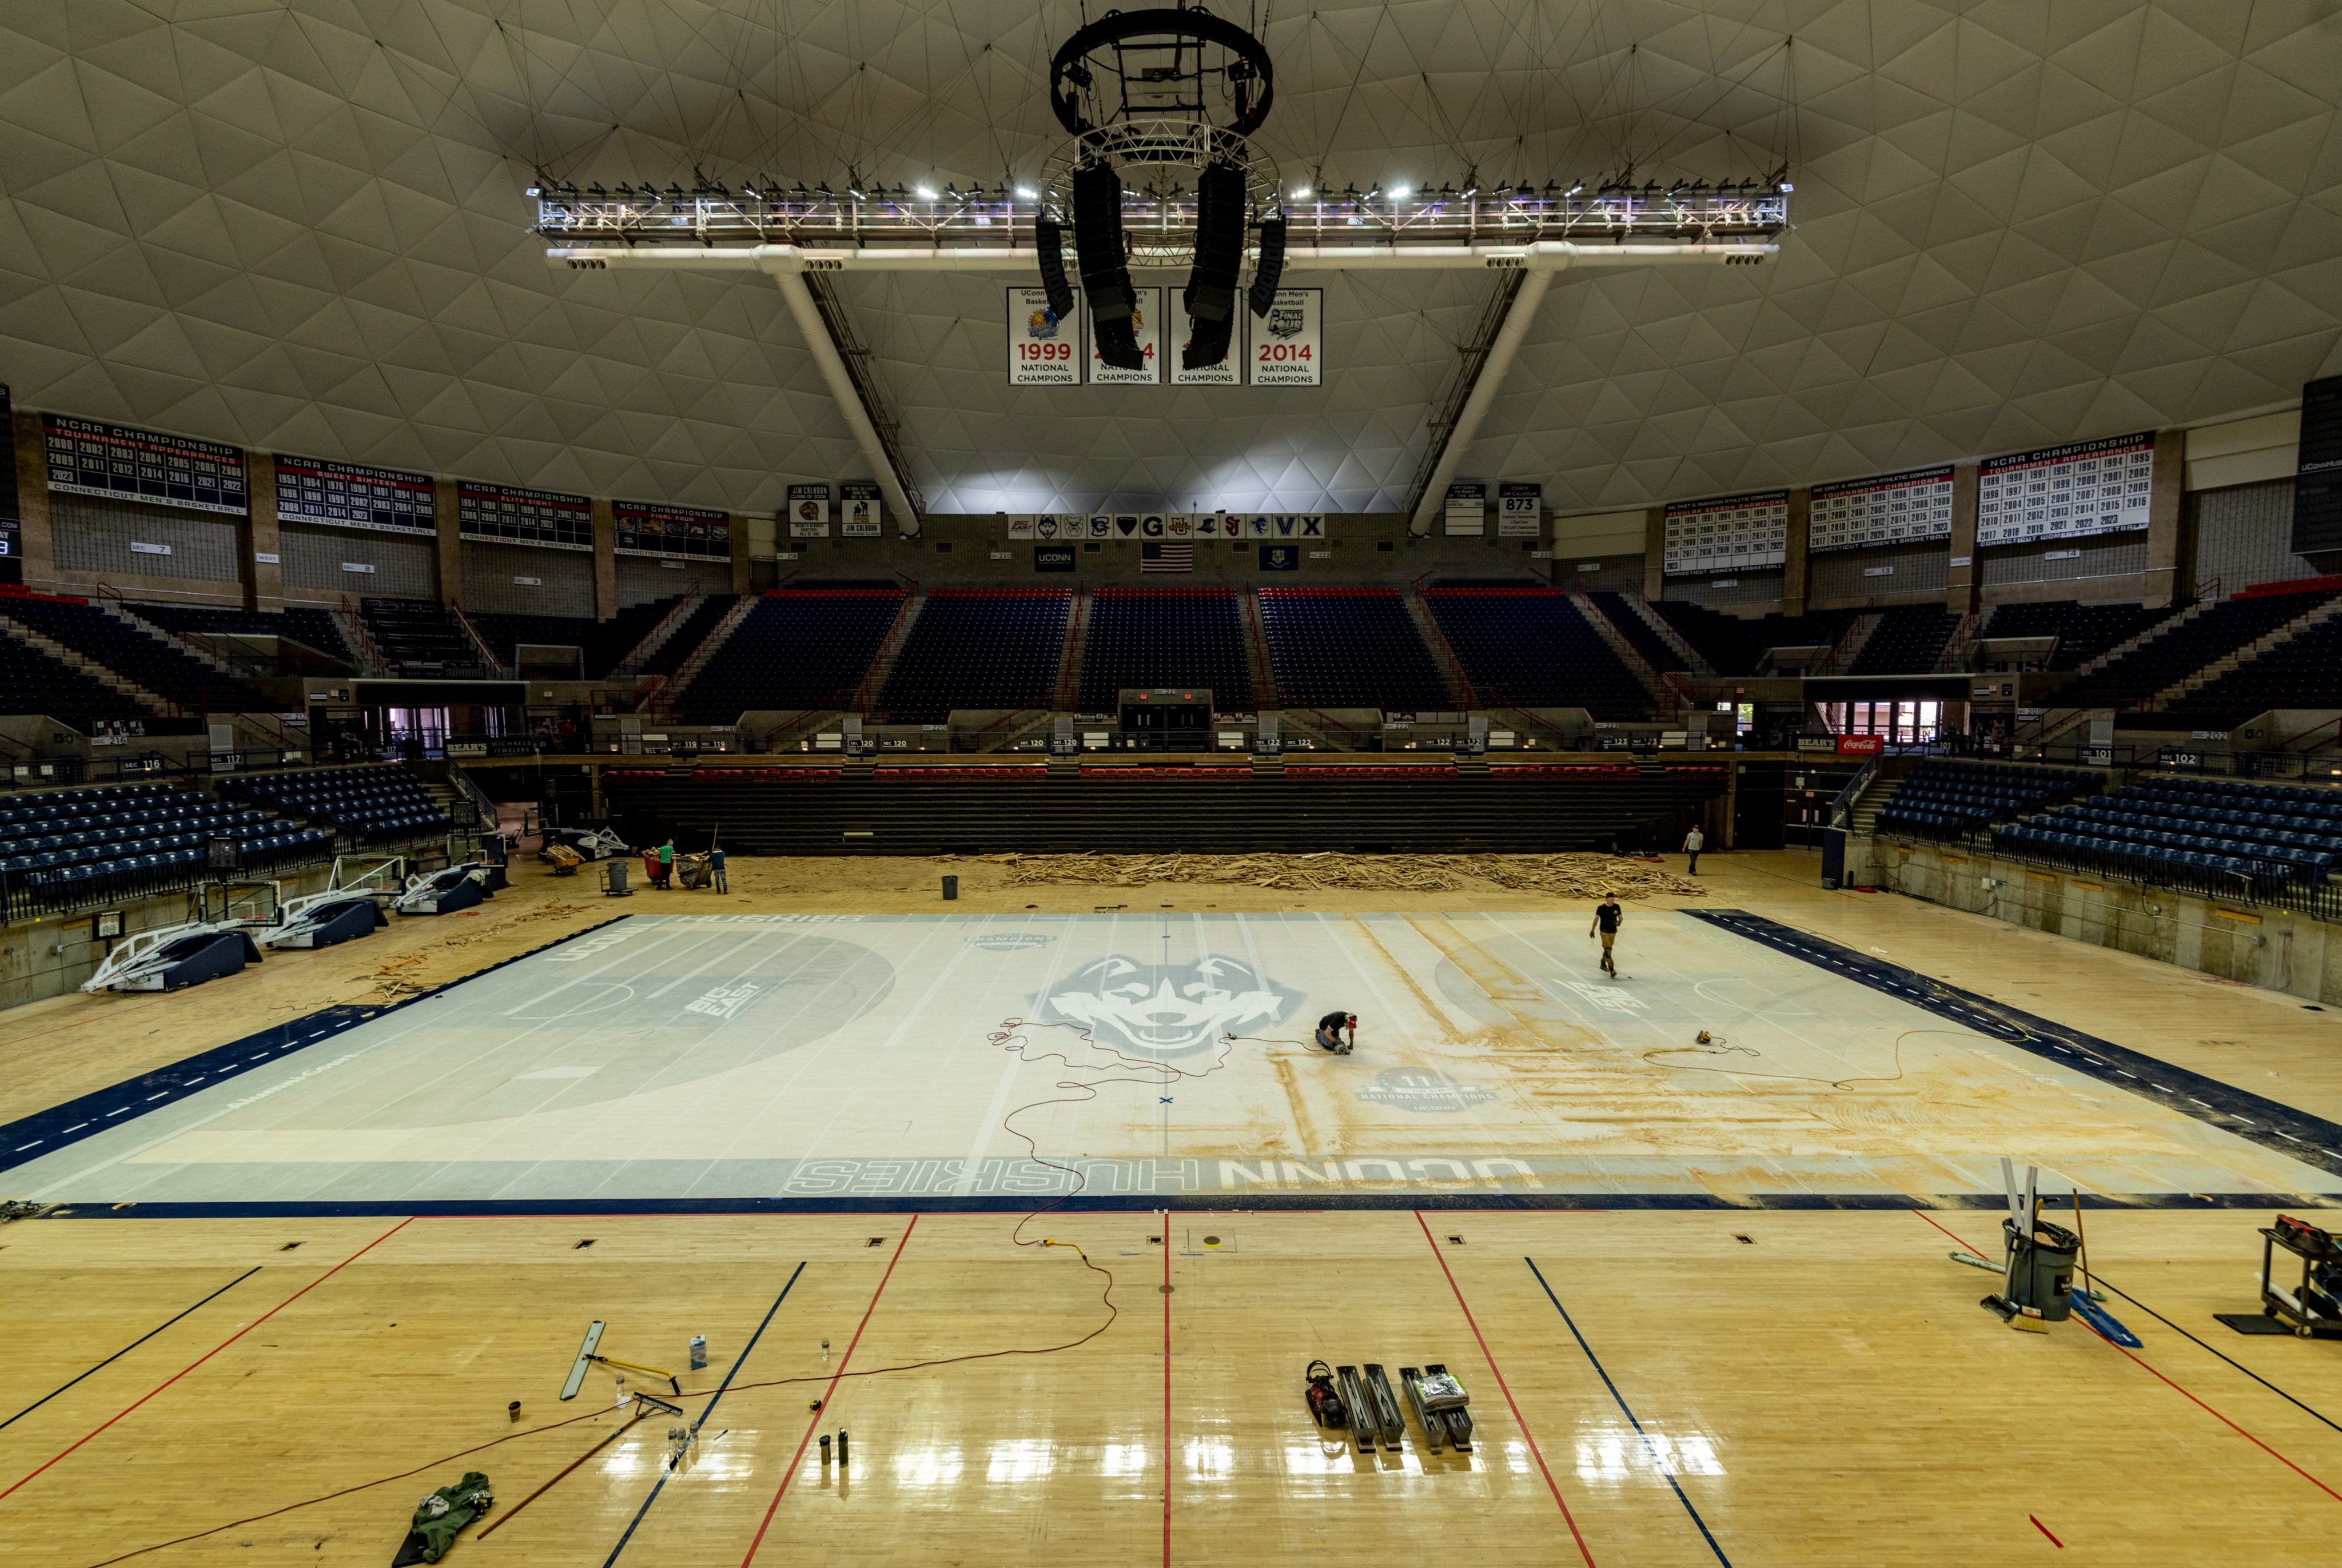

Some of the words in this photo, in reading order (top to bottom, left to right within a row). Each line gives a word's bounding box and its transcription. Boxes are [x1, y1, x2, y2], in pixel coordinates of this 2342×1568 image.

[1279, 310, 1303, 320] FINAL
[1018, 344, 1070, 360] 1999
[1259, 344, 1312, 361] 2014
[55, 428, 144, 449] TOURNAMENT
[150, 445, 236, 464] APPEARANCES
[56, 418, 103, 433] NCAA
[113, 429, 233, 455] CHAMPIONSHIP
[48, 436, 73, 450] 2000
[80, 442, 103, 455] 2002
[111, 447, 133, 460] 2003
[140, 452, 162, 464] 2004
[168, 456, 189, 469] 2005
[195, 461, 216, 473] 2006
[222, 465, 241, 477] 2008
[1989, 458, 2058, 474] TOURNAMENT
[2063, 444, 2145, 462] APPEARANCES
[1990, 455, 2026, 467] NCAA
[2033, 435, 2144, 461] CHAMPIONSHIP
[284, 457, 321, 469] NCAA
[328, 464, 424, 484] CHAMPIONSHIP
[317, 471, 352, 480] SWEET
[356, 476, 397, 486] SIXTEEN
[1847, 480, 1878, 489] AMERICAN
[1879, 475, 1908, 484] ATHLETIC
[1910, 468, 1950, 479] CONFERENCE
[1983, 477, 1999, 486] 1989
[2007, 473, 2022, 483] 1990
[2030, 469, 2046, 479] 1991
[2054, 465, 2070, 475] 1992
[2079, 461, 2096, 471] 1993
[2104, 457, 2122, 468] 1994
[2131, 452, 2150, 464] 1995
[1823, 486, 1881, 499] TOURNAMENT
[1885, 477, 1939, 490] CHAMPIONS
[1983, 490, 1998, 500] 1996
[2006, 486, 2021, 496] 1997
[2029, 482, 2045, 492] 1998
[2053, 479, 2070, 488] 1999
[2077, 475, 2096, 485] 2000
[2103, 471, 2122, 481] 2001
[2129, 467, 2149, 478] 2002
[54, 484, 134, 500] CONNECTICUT
[140, 495, 172, 505] MEN'S
[178, 501, 242, 514] BASKETBALL
[465, 484, 497, 493] NCAA
[502, 488, 584, 504] CHAMPIONSHIP
[1751, 492, 1785, 500] CONFERENCE
[620, 503, 646, 511] NCAA
[651, 506, 722, 518] CHAMPIONSHIP
[1507, 498, 1533, 510] 873
[1739, 500, 1786, 508] CHAMPIONS
[1981, 516, 1998, 526] 2010
[2004, 513, 2021, 523] 2011
[2027, 510, 2044, 520] 2012
[2052, 507, 2069, 517] 2013
[2075, 504, 2094, 514] 2014
[2101, 500, 2120, 511] 2015
[2128, 496, 2146, 507] 2016
[282, 514, 348, 525] CONNECTICUT
[380, 525, 432, 534] BASKETBALL
[1143, 517, 1163, 536] G
[1275, 517, 1296, 536] V
[1303, 517, 1321, 535] X
[464, 533, 516, 544] CONNECTICUT
[545, 542, 589, 550] BASKETBALL
[1810, 544, 1859, 553] CONNECTICUT
[1862, 538, 1897, 548] WOMEN'S
[1899, 534, 1950, 544] BASKETBALL
[1980, 536, 2036, 547] CONNECTICUT
[2041, 530, 2080, 540] WOMEN'S
[2084, 523, 2144, 535] BASKETBALL
[1843, 740, 1877, 749] Coca-Cola
[2206, 731, 2226, 740] 202
[226, 755, 241, 763] 117
[2096, 749, 2112, 758] 101
[2175, 754, 2196, 763] 102
[143, 760, 161, 769] 116
[674, 915, 867, 923] HUSKIES
[545, 921, 660, 962] UCONN
[684, 986, 736, 1015] BIG
[703, 981, 762, 1019] EAST
[226, 1076, 306, 1109] Alumni
[301, 1054, 360, 1075] Court
[1402, 1076, 1431, 1087] 11
[784, 1159, 1199, 1194] HUSKIES
[1219, 1158, 1545, 1190] UCONN
